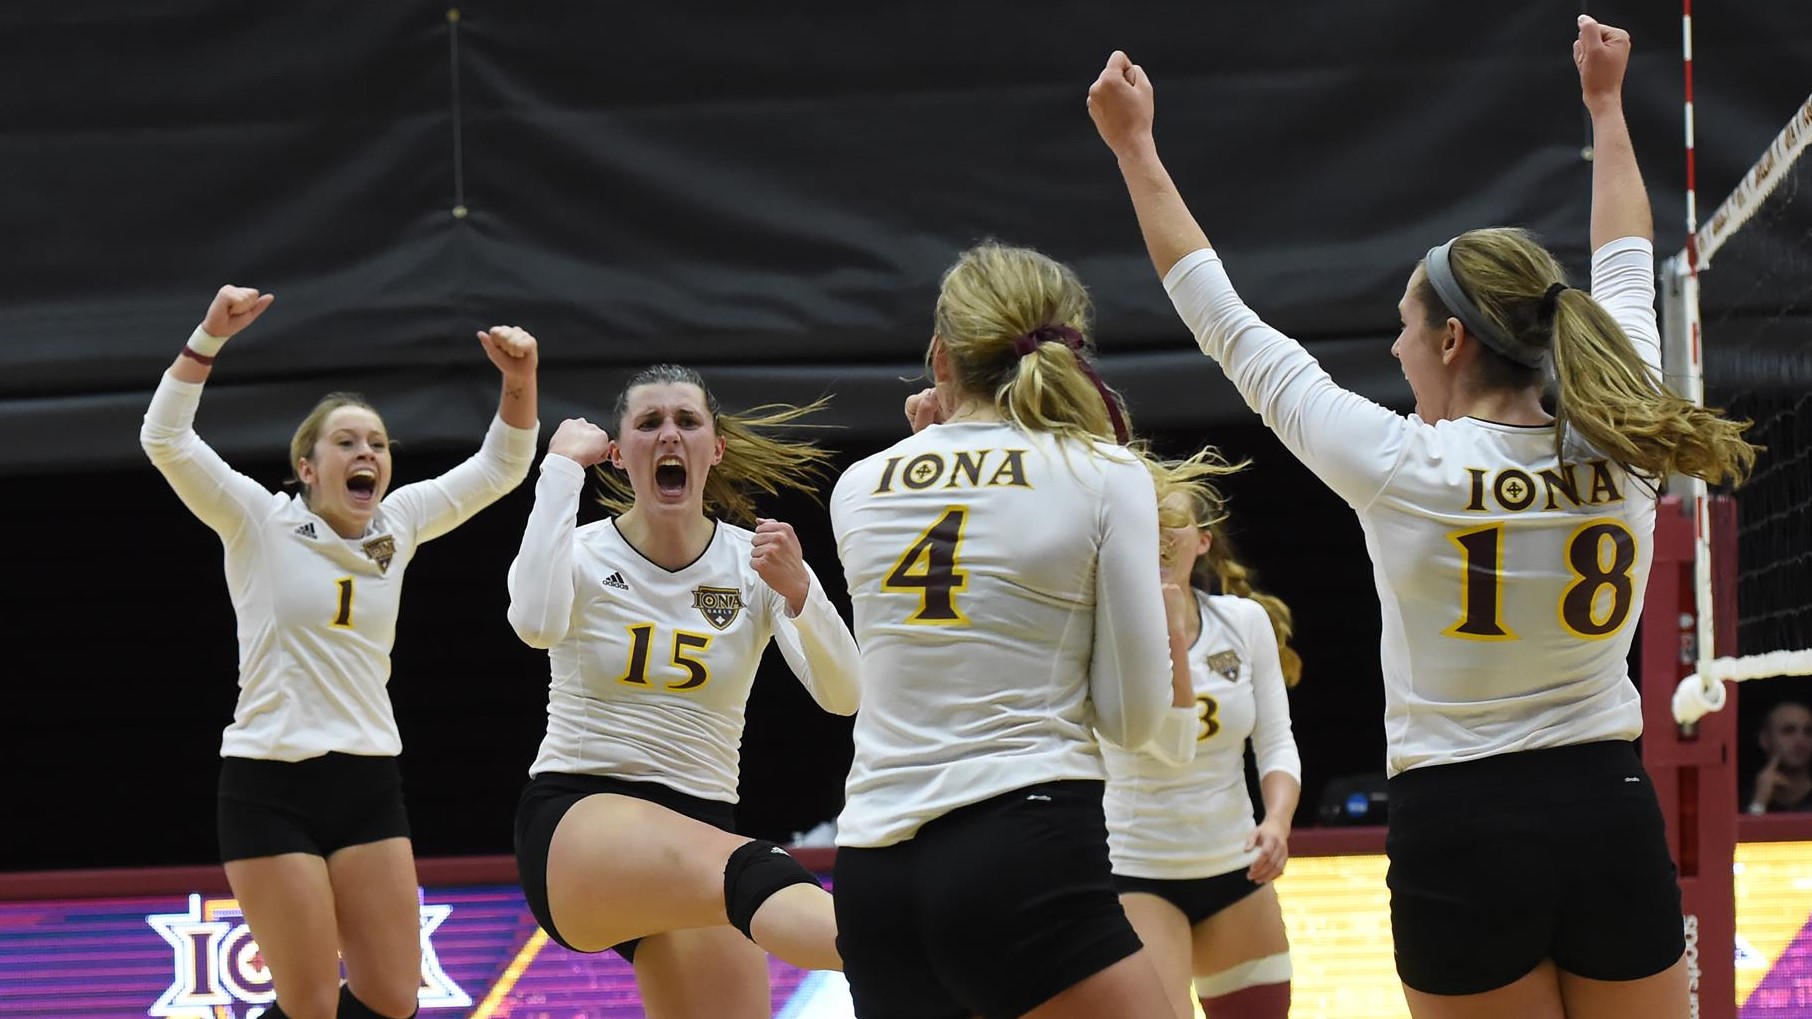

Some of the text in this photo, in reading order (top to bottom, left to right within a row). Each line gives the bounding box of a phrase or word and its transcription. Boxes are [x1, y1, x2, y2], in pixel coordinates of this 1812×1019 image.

[870, 449, 1034, 496] IONA
[1464, 459, 1626, 512] IONA
[602, 578, 629, 591] adidas
[881, 505, 972, 626] 4
[1440, 517, 1638, 640] 18
[328, 575, 355, 629] 1
[692, 591, 745, 610] IONA
[616, 621, 714, 692] 15
[1195, 692, 1222, 742] 3
